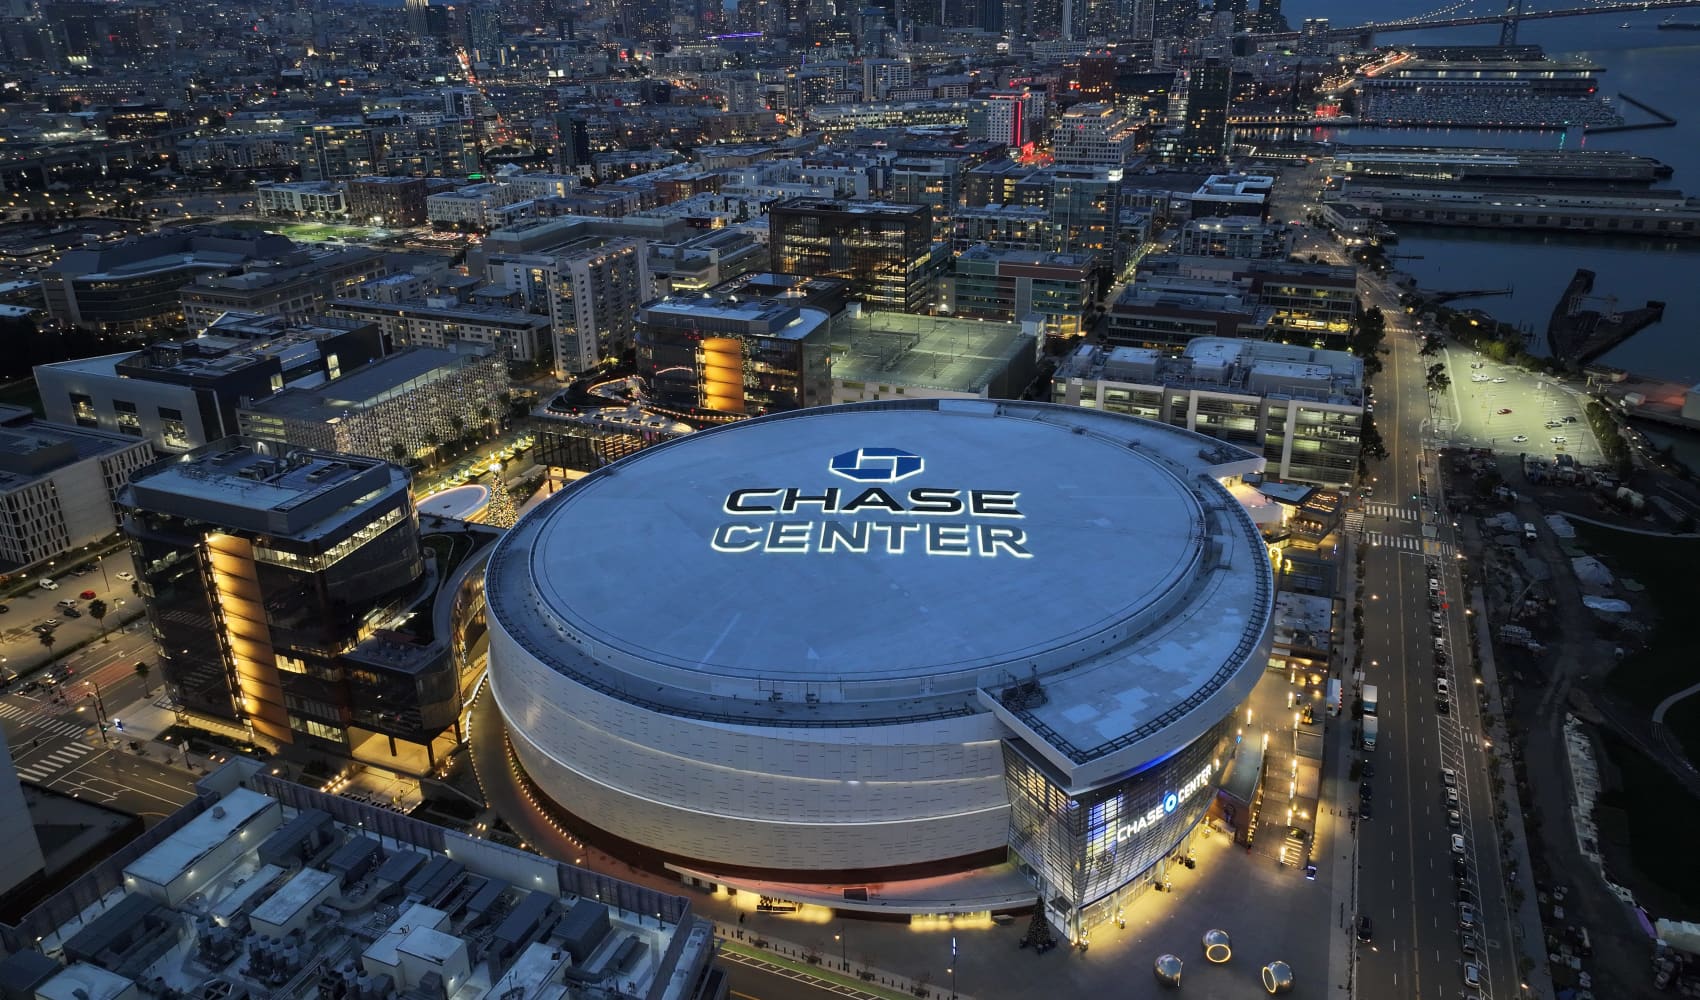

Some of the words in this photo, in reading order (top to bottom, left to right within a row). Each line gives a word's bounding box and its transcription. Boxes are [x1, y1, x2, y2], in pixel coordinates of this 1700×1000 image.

[723, 487, 1026, 518] CHASE
[711, 520, 1034, 558] CENTER
[1117, 803, 1164, 843] CHASE
[1178, 763, 1212, 803] CENTER
